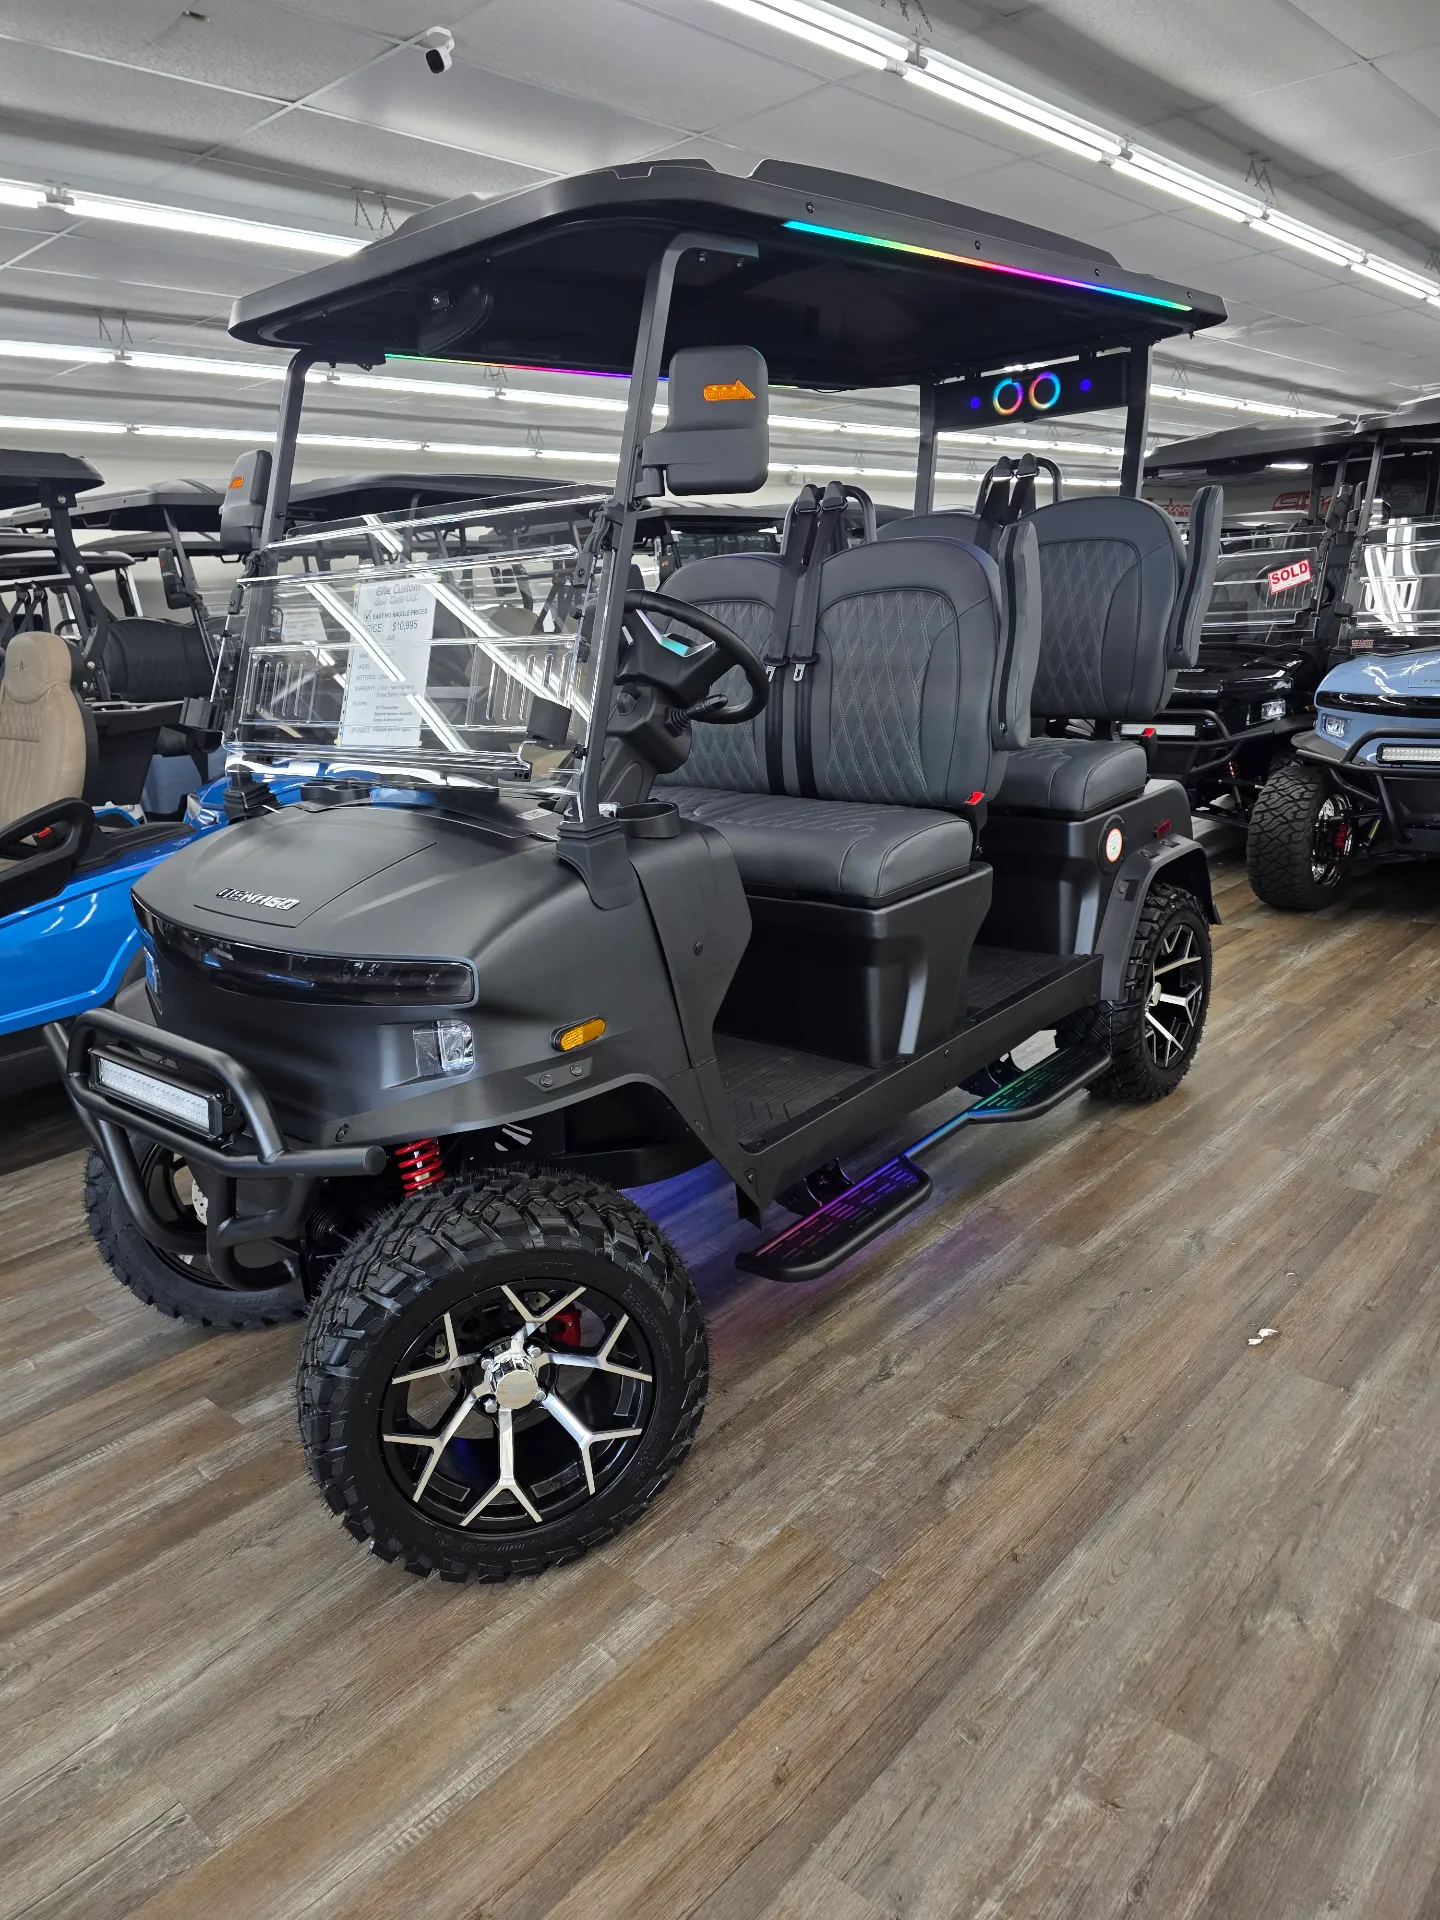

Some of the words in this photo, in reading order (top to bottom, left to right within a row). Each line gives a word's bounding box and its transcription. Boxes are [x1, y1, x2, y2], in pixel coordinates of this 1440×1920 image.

[1271, 562, 1308, 585] SOLD
[393, 582, 421, 595] Custom
[373, 612, 384, 620] EASY
[410, 608, 428, 617] PRICES
[392, 619, 418, 632] $10,995
[216, 888, 300, 911] DENAGO
